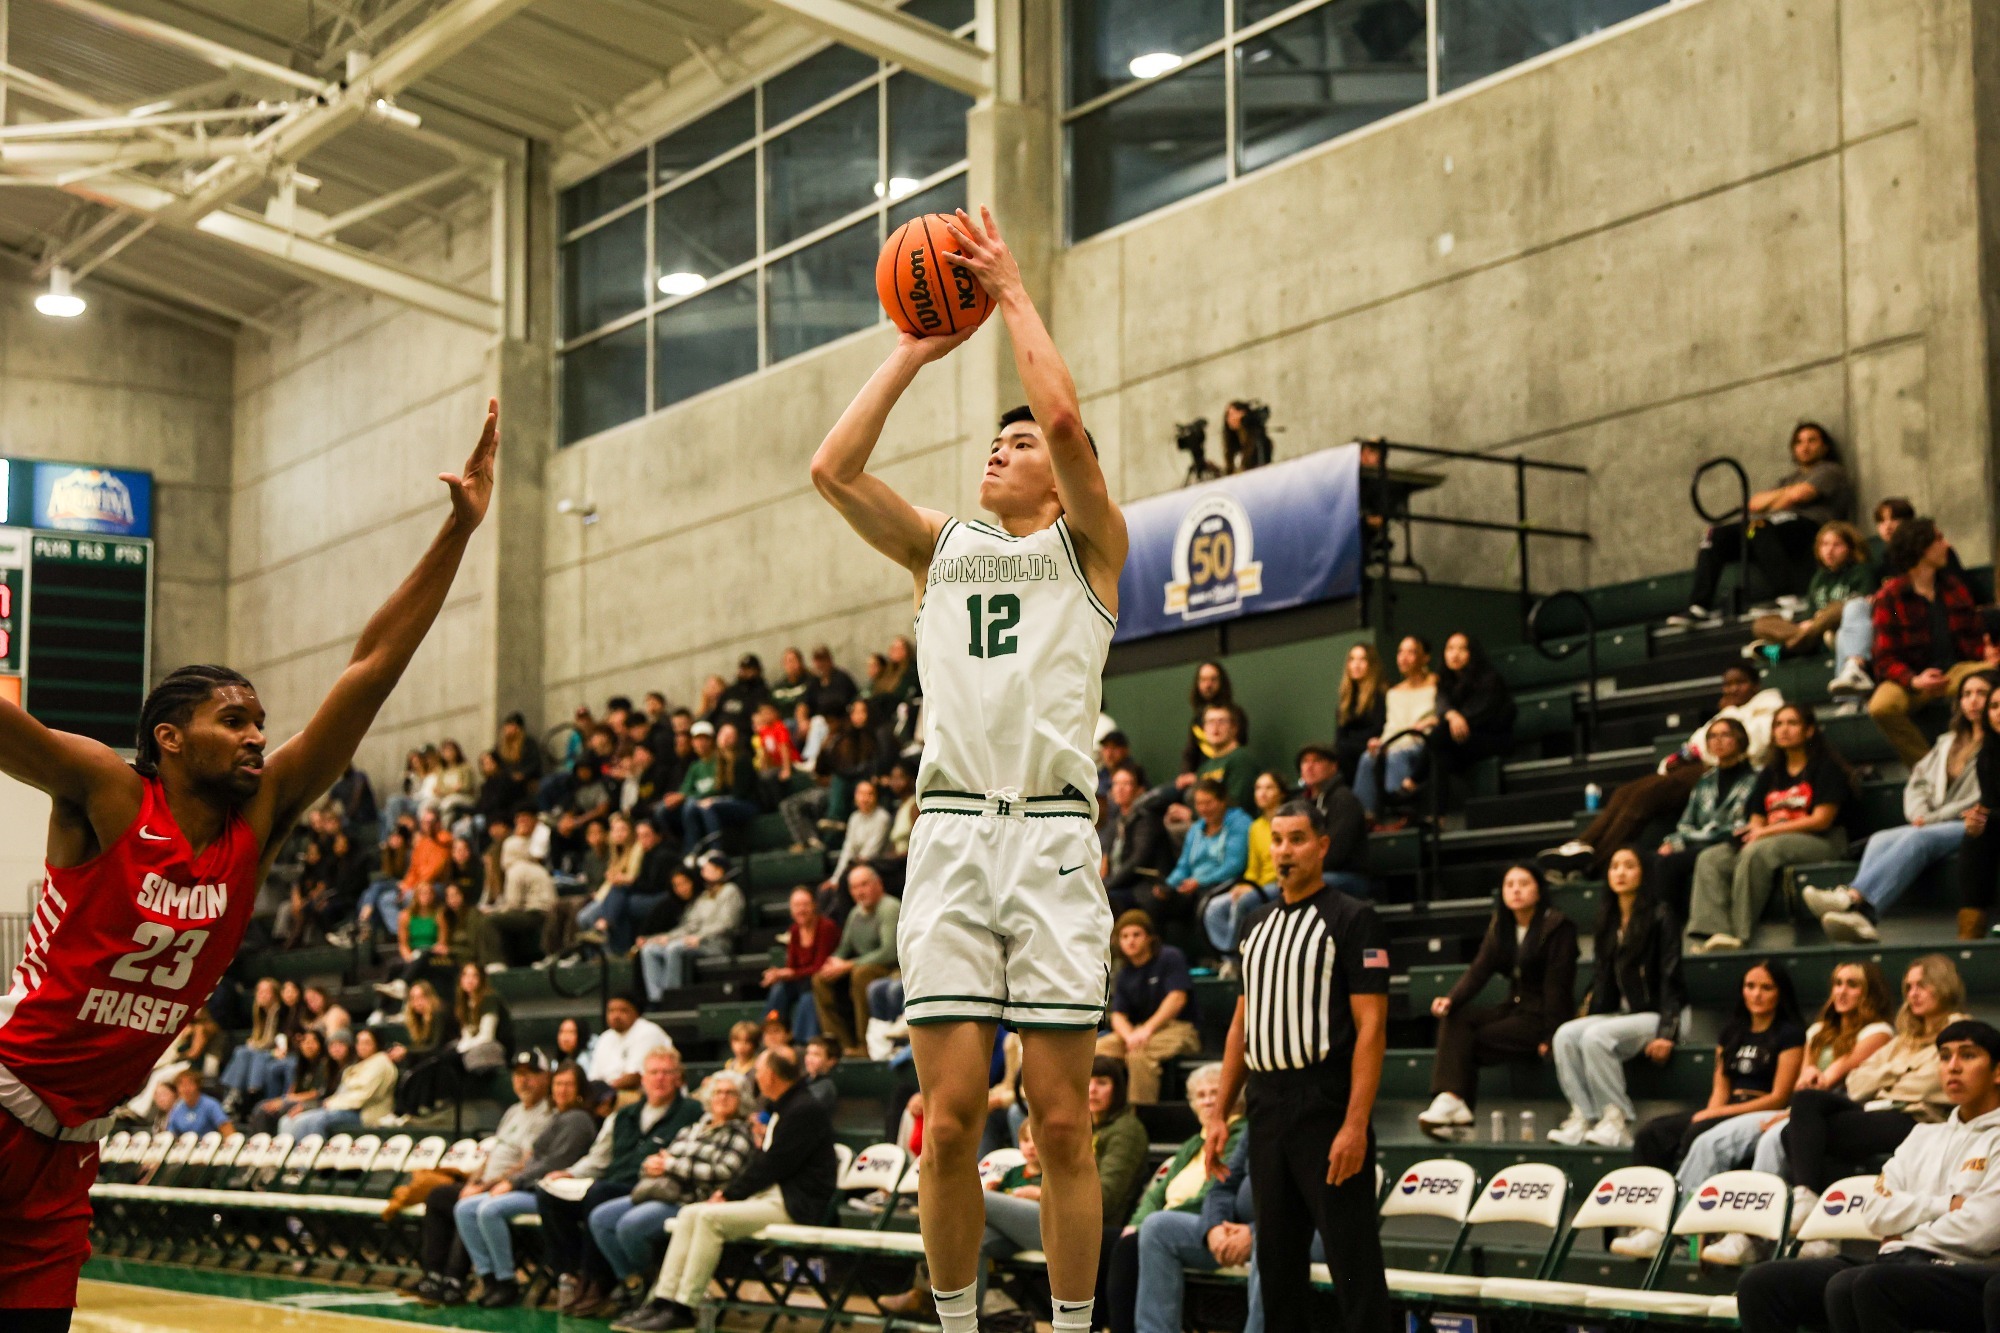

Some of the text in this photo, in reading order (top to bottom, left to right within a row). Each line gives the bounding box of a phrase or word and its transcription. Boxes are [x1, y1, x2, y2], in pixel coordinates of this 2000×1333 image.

[910, 247, 942, 331] Wilson
[930, 554, 1059, 587] HUMBOLDT
[1191, 531, 1235, 586] 50
[966, 593, 1021, 659] 12
[136, 872, 228, 920] SIMON
[109, 921, 210, 990] 23
[76, 987, 189, 1035] FRASER
[1418, 1176, 1464, 1196] PEPSI
[1507, 1182, 1555, 1200] PEPSI
[1614, 1186, 1664, 1204] PEPSI
[1719, 1191, 1775, 1211] PEPSI
